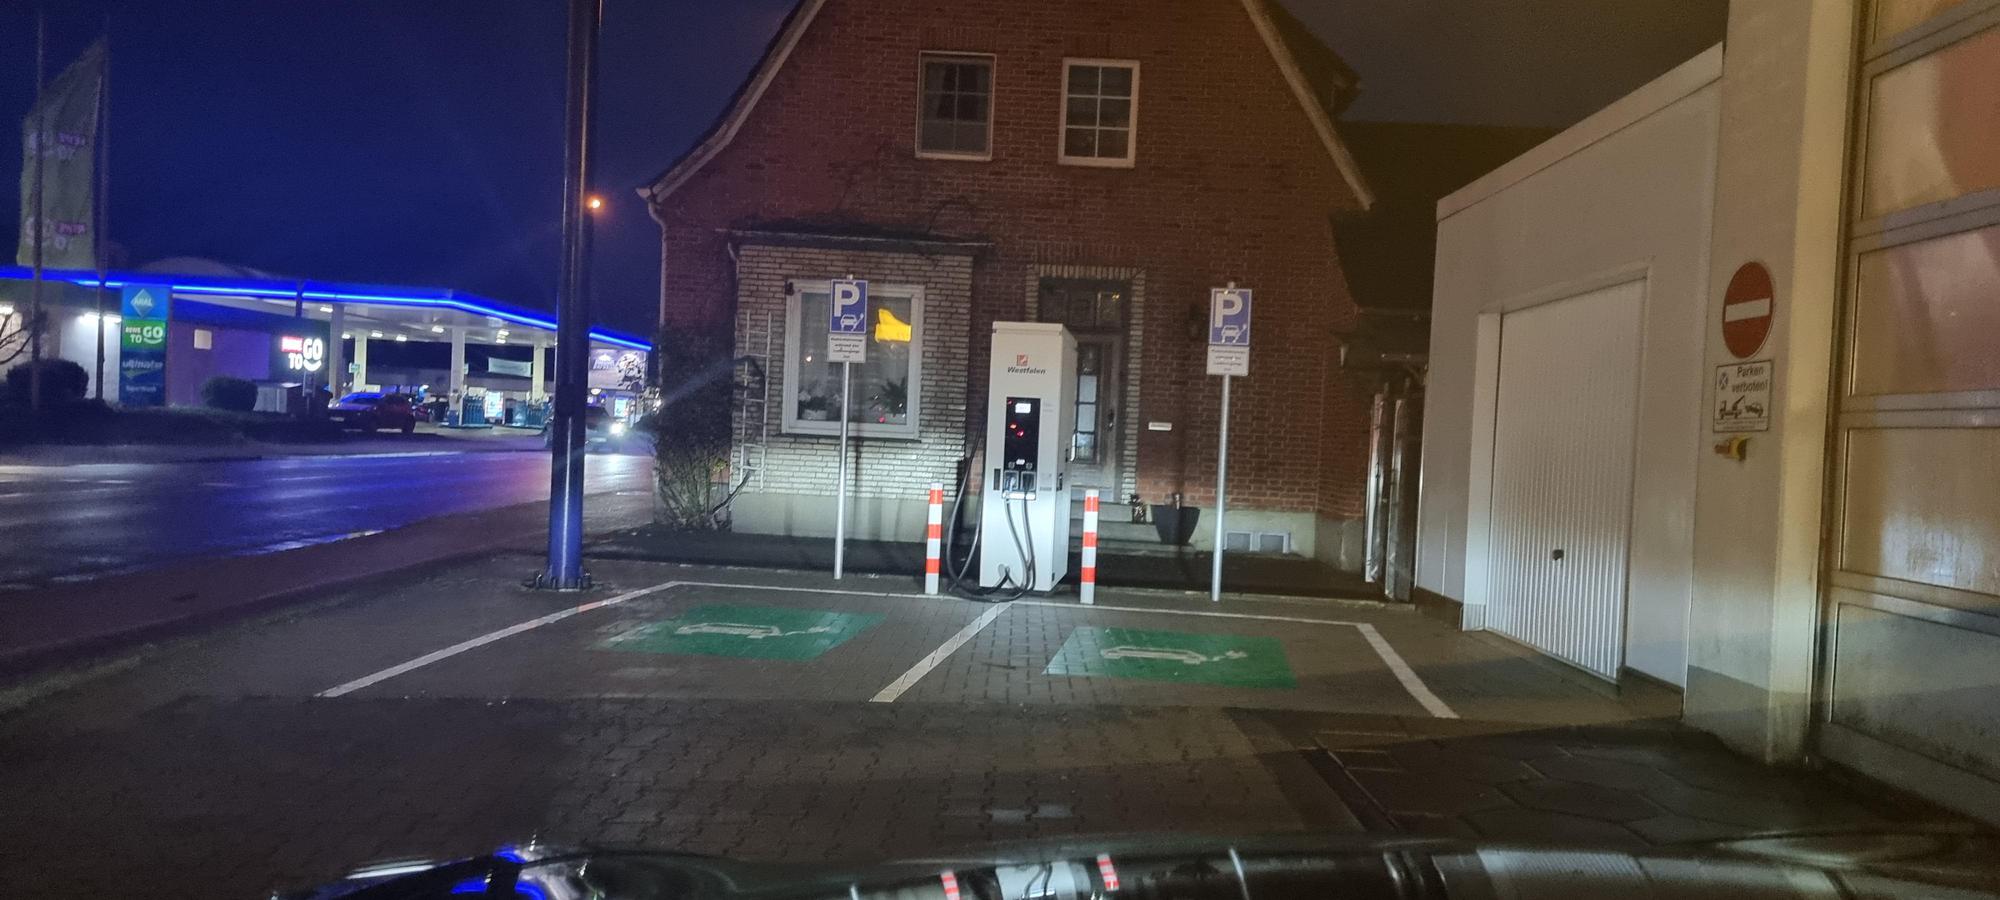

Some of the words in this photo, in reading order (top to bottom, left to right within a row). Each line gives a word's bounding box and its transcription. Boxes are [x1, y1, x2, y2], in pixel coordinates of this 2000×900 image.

[834, 283, 860, 317] P
[1215, 292, 1243, 328] P
[130, 334, 142, 344] TO
[142, 326, 163, 338] GO
[303, 338, 323, 360] GO
[288, 352, 303, 370] TO
[1007, 366, 1046, 375] Westfalen
[1737, 366, 1764, 377] Parken
